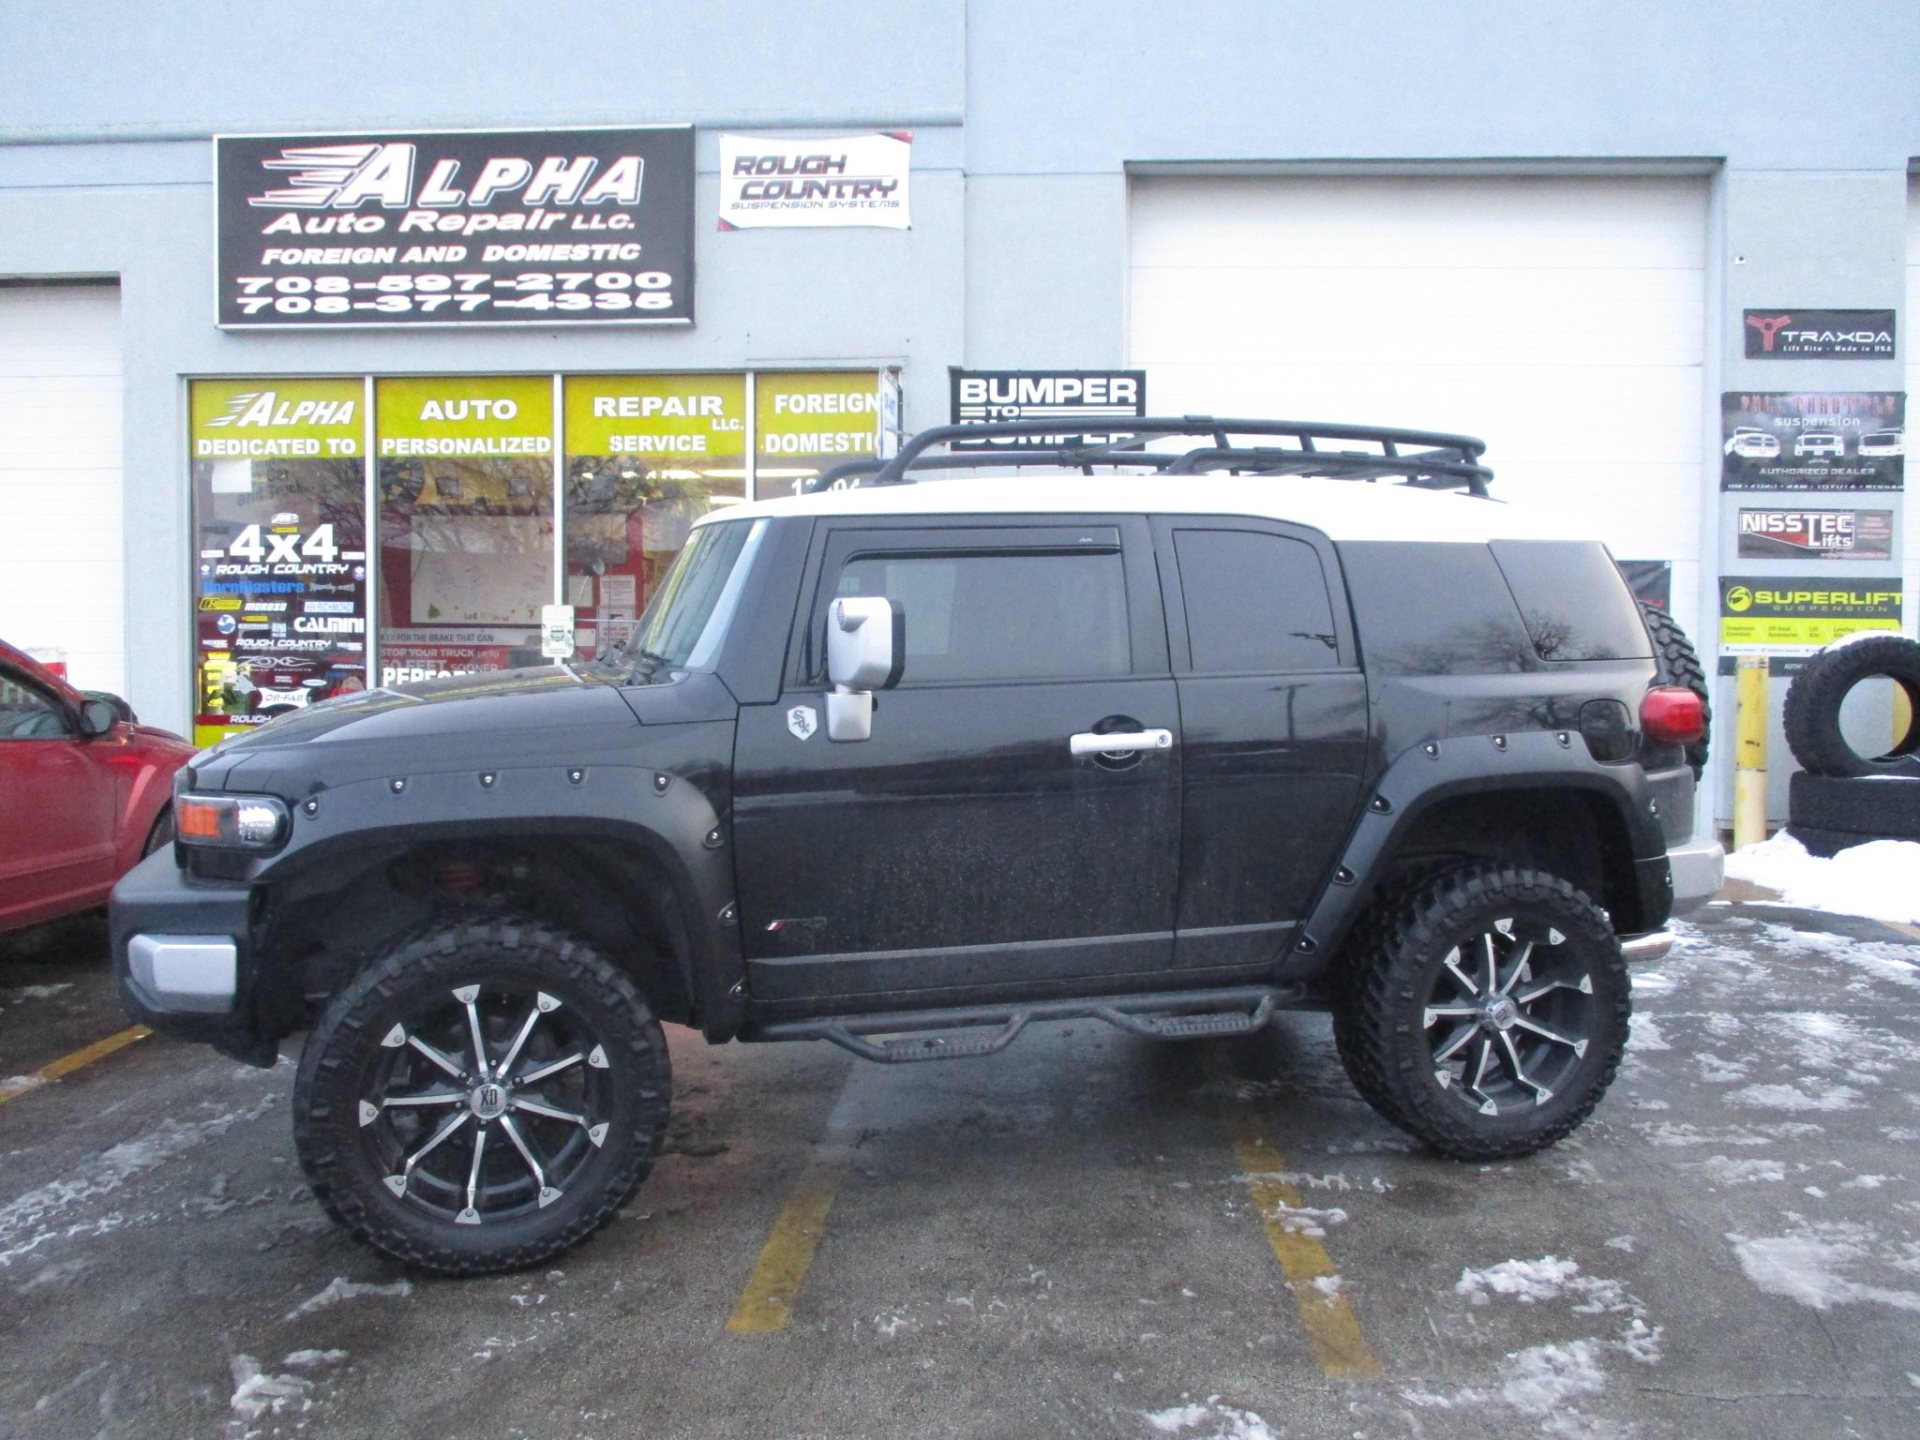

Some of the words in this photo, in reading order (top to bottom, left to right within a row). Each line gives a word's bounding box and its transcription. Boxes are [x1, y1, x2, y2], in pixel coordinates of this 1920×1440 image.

[333, 143, 645, 209] ALPHA
[733, 155, 847, 176] ROUGH
[739, 179, 899, 201] COUNTRY
[731, 201, 824, 210] SUSPENSION
[828, 200, 900, 209] SYSTEMS
[262, 212, 386, 235] Auto
[399, 209, 566, 236] Repair
[261, 247, 397, 266] FOREIGN
[401, 246, 467, 264] AND
[482, 244, 642, 262] DOMESTIC
[236, 272, 673, 294] 708-597-2700
[1781, 331, 1892, 343] TRAXDA
[959, 377, 1138, 404] BUMPER
[236, 391, 355, 427] ALPHA
[420, 400, 518, 421] AUTO
[593, 396, 724, 417] REPAIR
[774, 393, 881, 414] FOREIGN
[987, 406, 1020, 417] TO
[712, 418, 744, 431] LLC.
[198, 438, 320, 456] DEDICATED
[326, 438, 357, 455] TO
[381, 437, 551, 454] PERSONALIZED
[609, 435, 706, 452] SERVICE
[229, 524, 339, 562] 4x4
[216, 564, 269, 575] ROUGH
[274, 564, 349, 575] COUNTRY
[1754, 591, 1903, 605] SUPERLIFT
[235, 638, 275, 646] ROUGH
[277, 639, 332, 647] COUNTRY
[396, 632, 410, 642] FOR
[412, 633, 428, 642] THE
[429, 633, 454, 643] BRAKE
[456, 633, 475, 643] THAT
[477, 633, 495, 643] CAN
[409, 648, 438, 657] YOUR
[440, 648, 475, 657] TRUCK
[480, 1088, 498, 1106] XD
